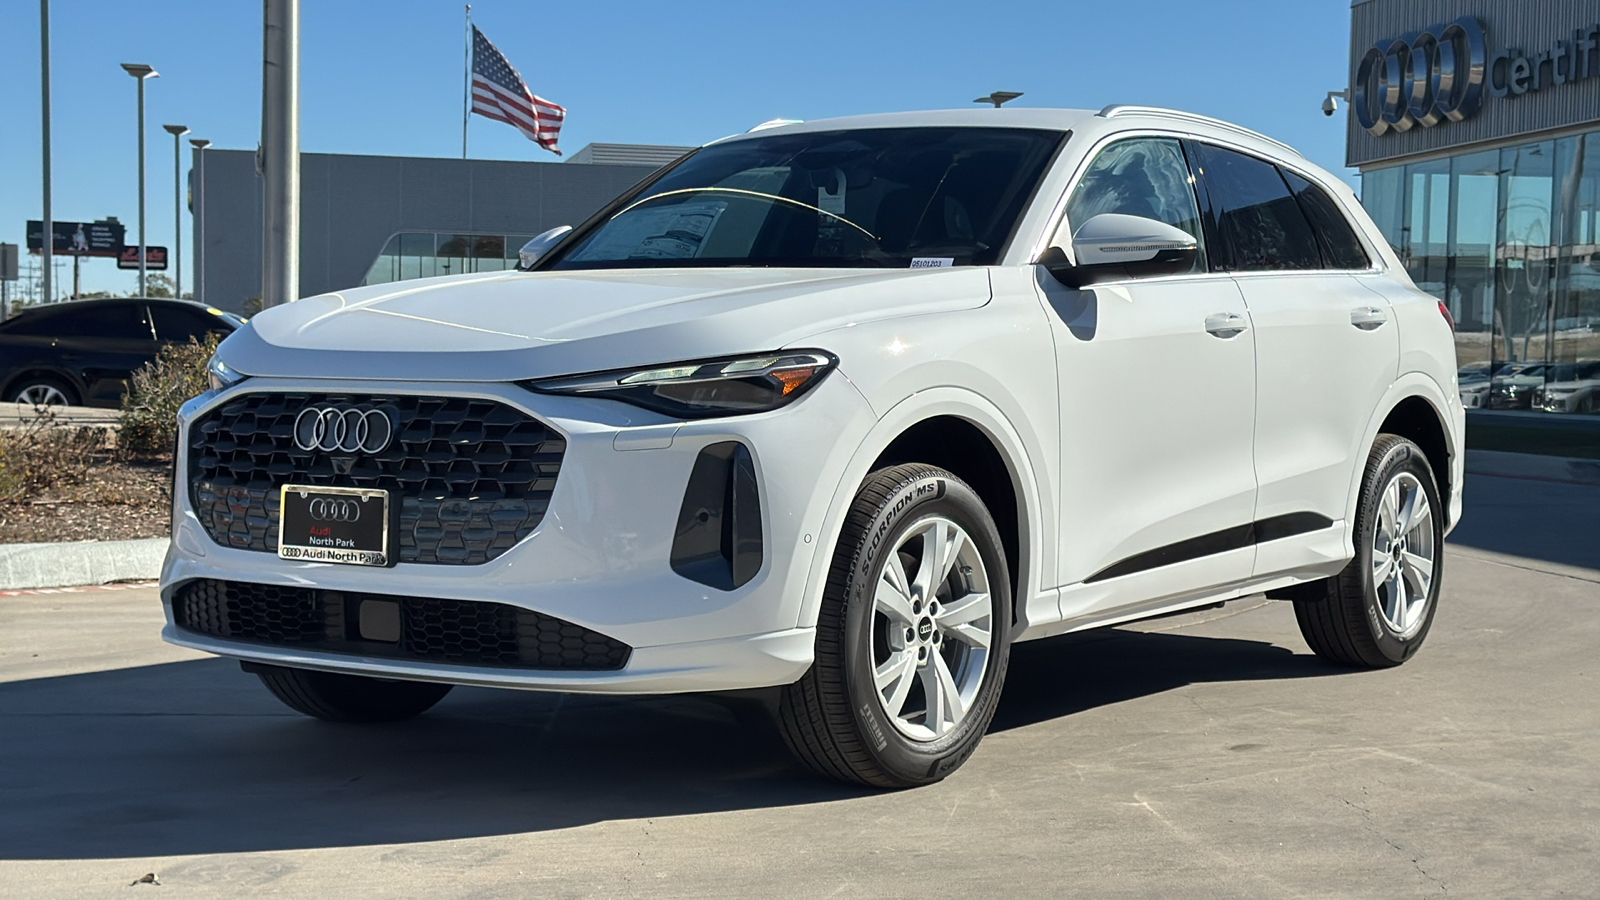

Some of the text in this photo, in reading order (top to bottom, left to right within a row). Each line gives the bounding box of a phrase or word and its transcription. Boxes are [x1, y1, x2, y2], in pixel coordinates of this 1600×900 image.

[1487, 23, 1600, 98] Certif
[309, 536, 355, 548] North Park
[310, 526, 331, 536] Audi
[862, 483, 935, 577] SCORPION MS
[302, 549, 385, 564] Audi North Park
[860, 703, 888, 753] PIRELLI
